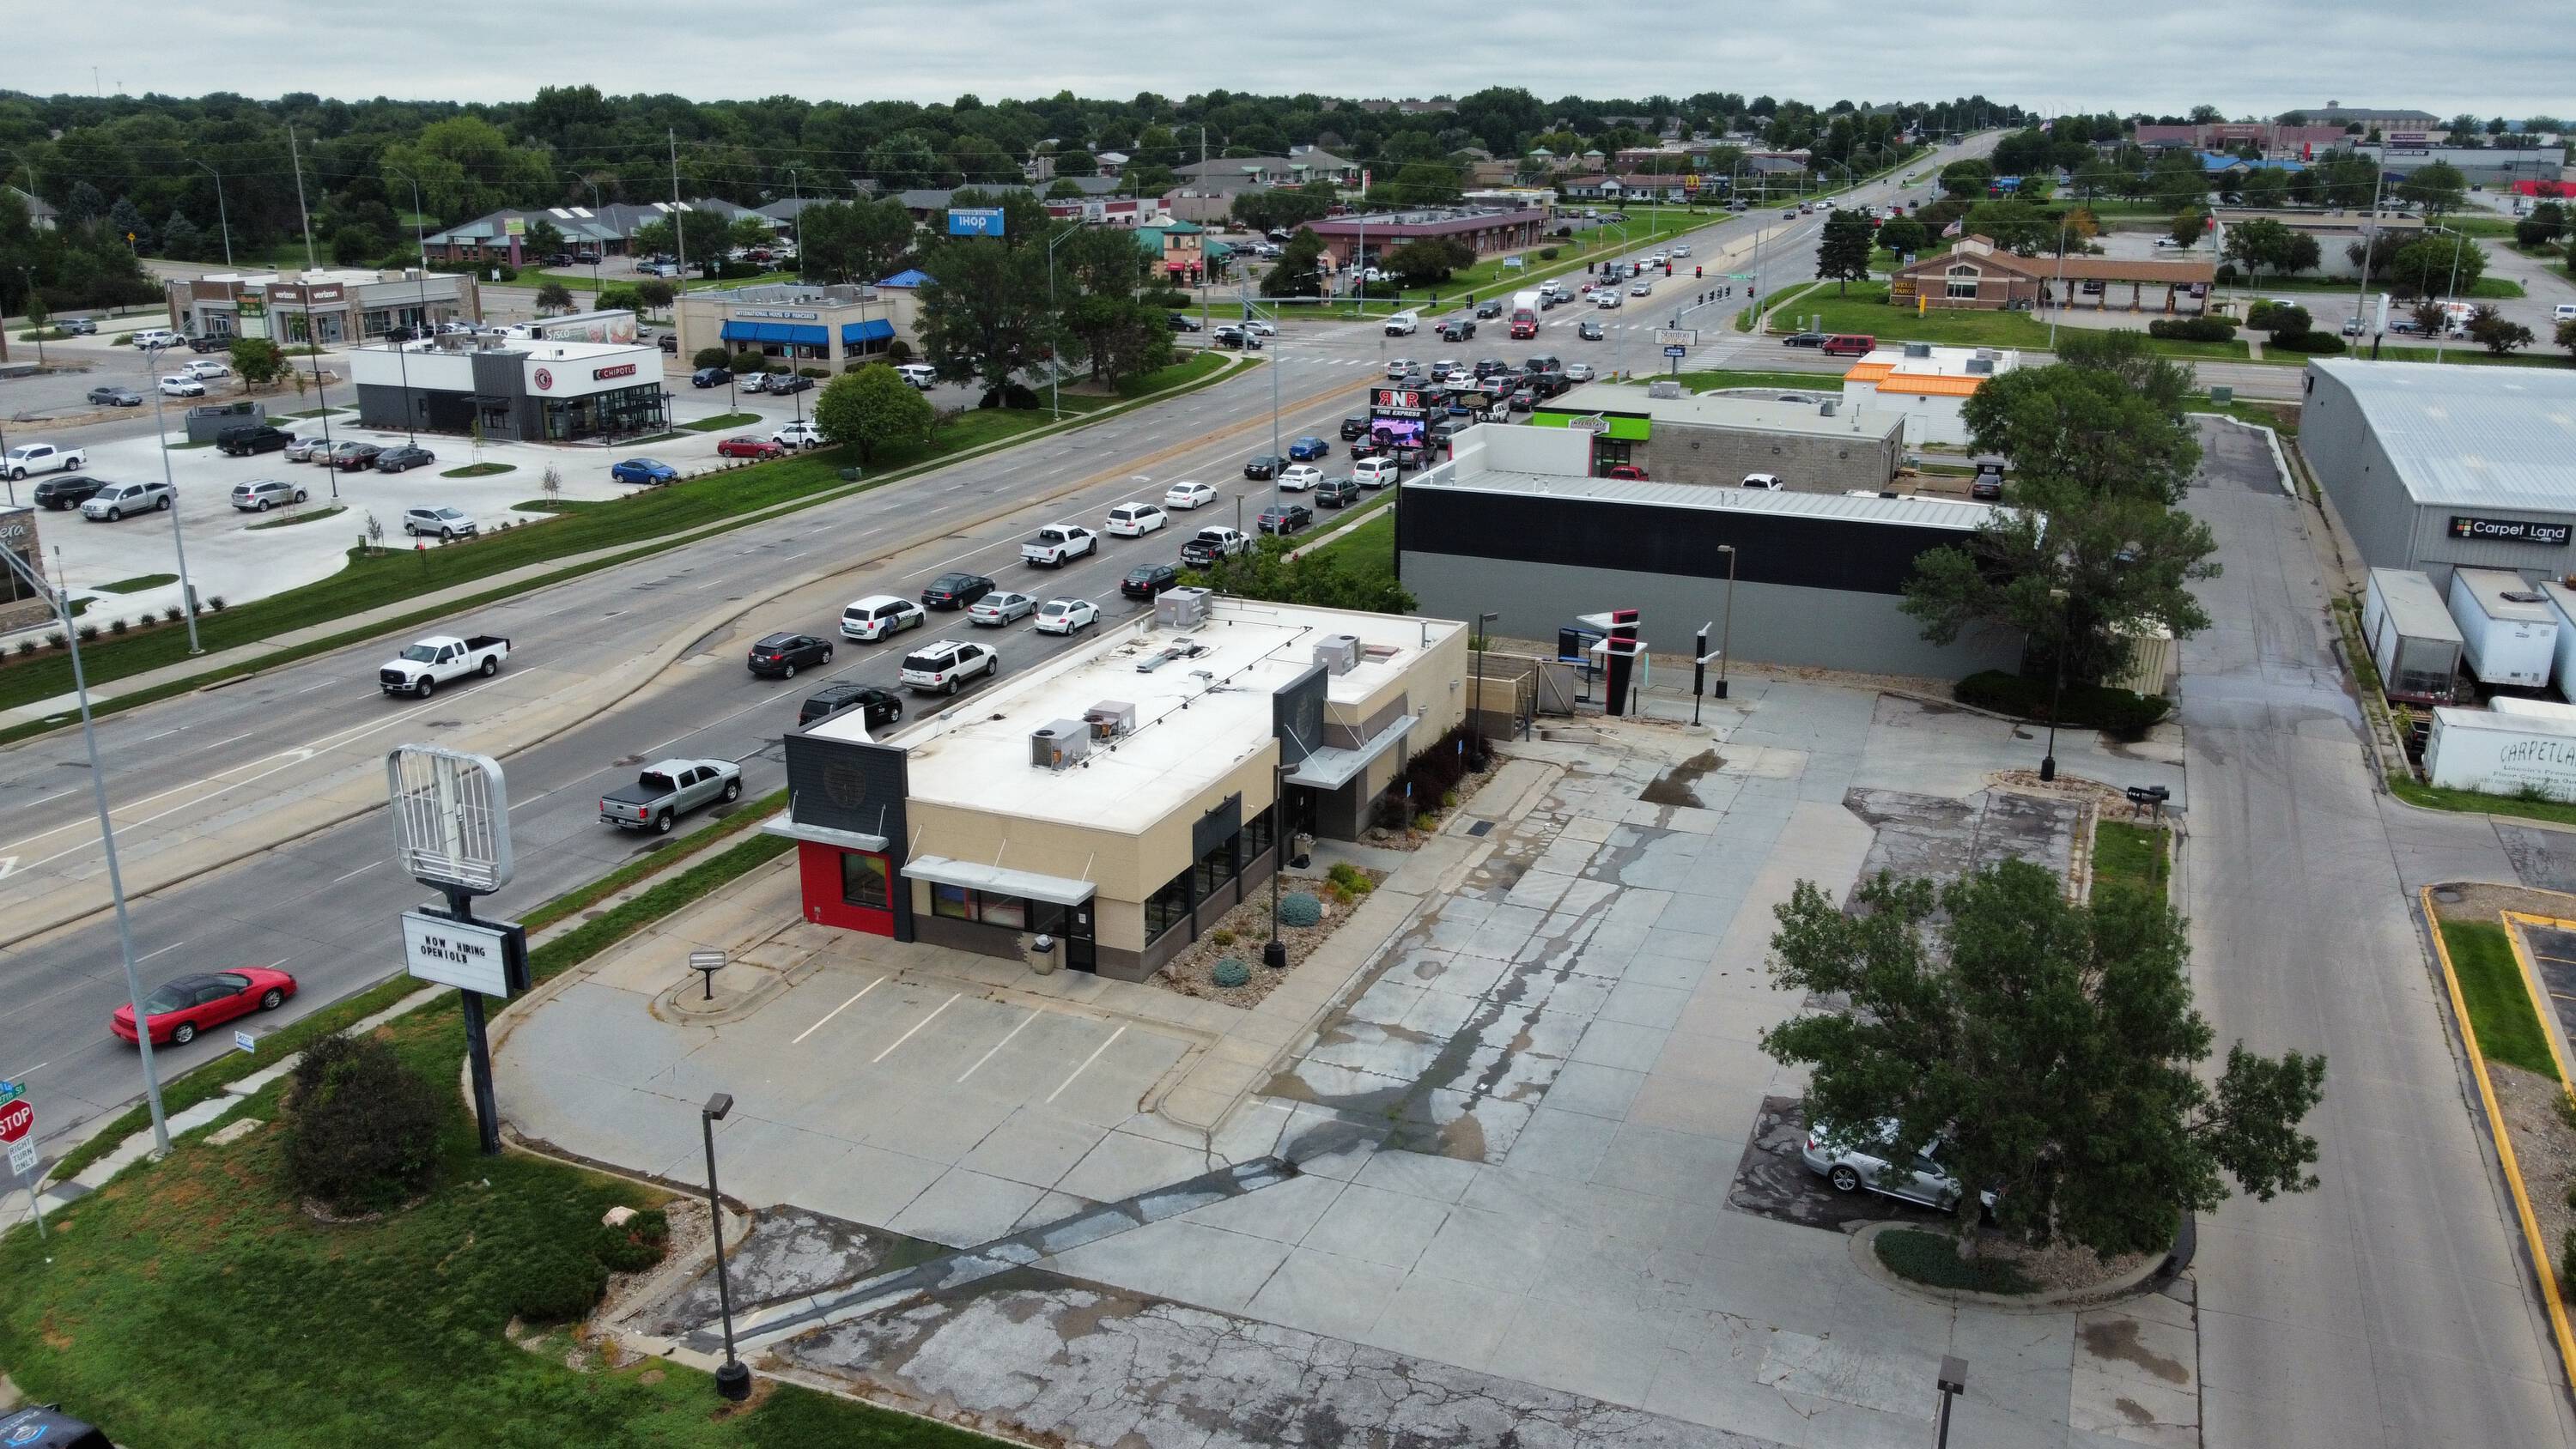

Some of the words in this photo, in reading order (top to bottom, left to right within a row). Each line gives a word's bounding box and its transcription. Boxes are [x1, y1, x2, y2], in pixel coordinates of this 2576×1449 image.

[959, 215, 987, 229] IHOP
[275, 290, 296, 300] verizon
[313, 290, 337, 300] verizon
[1662, 330, 1690, 338] Stanton
[604, 366, 636, 378] CHIPOTLE
[1378, 390, 1419, 408] RNR
[2474, 521, 2524, 537] Carpet
[2530, 525, 2566, 538] Land
[2500, 741, 2576, 767] CARPETLA
[425, 936, 446, 948] NOW
[457, 942, 486, 957] HIRING
[0, 1106, 30, 1137] STOP
[9, 1137, 31, 1155] RIGHT
[14, 1147, 33, 1162] TURN
[15, 1158, 34, 1172] ONLY
